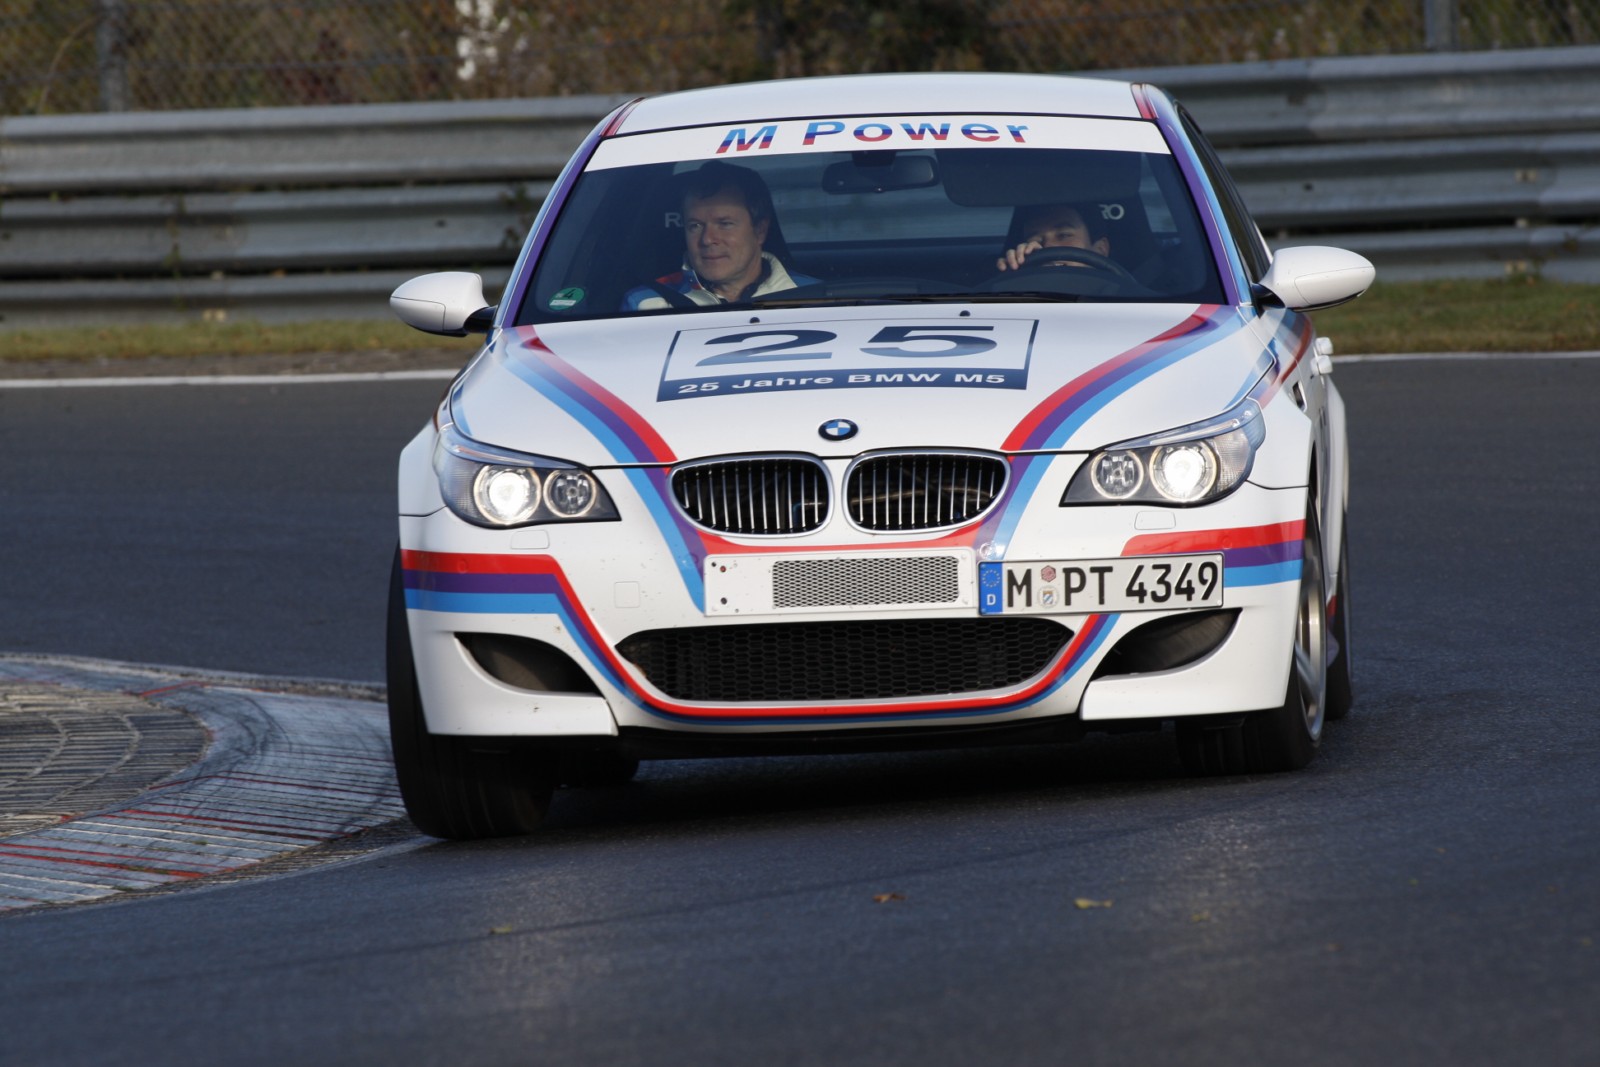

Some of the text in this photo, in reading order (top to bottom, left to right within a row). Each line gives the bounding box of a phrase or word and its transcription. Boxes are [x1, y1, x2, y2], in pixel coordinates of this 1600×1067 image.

[715, 121, 1029, 154] M Power
[695, 325, 998, 367] 25
[678, 373, 1005, 394] 25 Jahre BMW M5
[986, 594, 996, 606] D
[1007, 561, 1219, 607] M PT 4349
